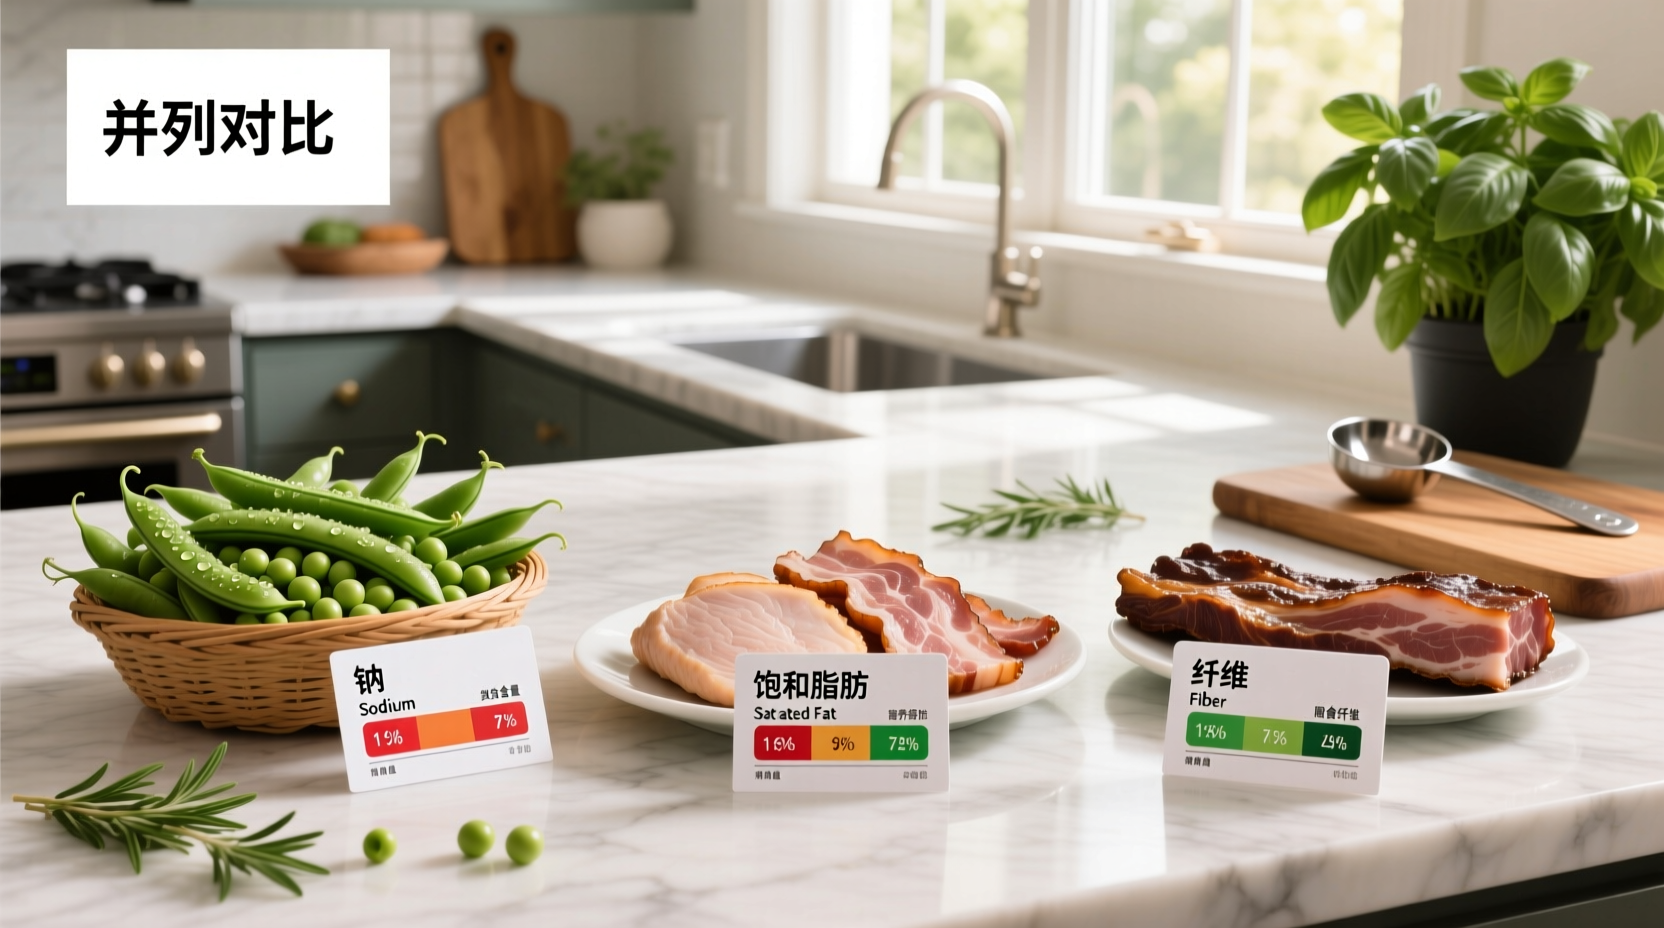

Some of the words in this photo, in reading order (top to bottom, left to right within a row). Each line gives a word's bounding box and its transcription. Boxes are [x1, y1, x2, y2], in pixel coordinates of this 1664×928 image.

[353, 663, 385, 695] 钠
[1190, 658, 1249, 690] 纤维
[753, 670, 869, 700] 饱和脂肪
[359, 698, 416, 716] Sodium
[1189, 691, 1227, 708] Fiber
[494, 713, 517, 729] 7%
[814, 706, 837, 720] Fat
[832, 736, 855, 751] 9%
